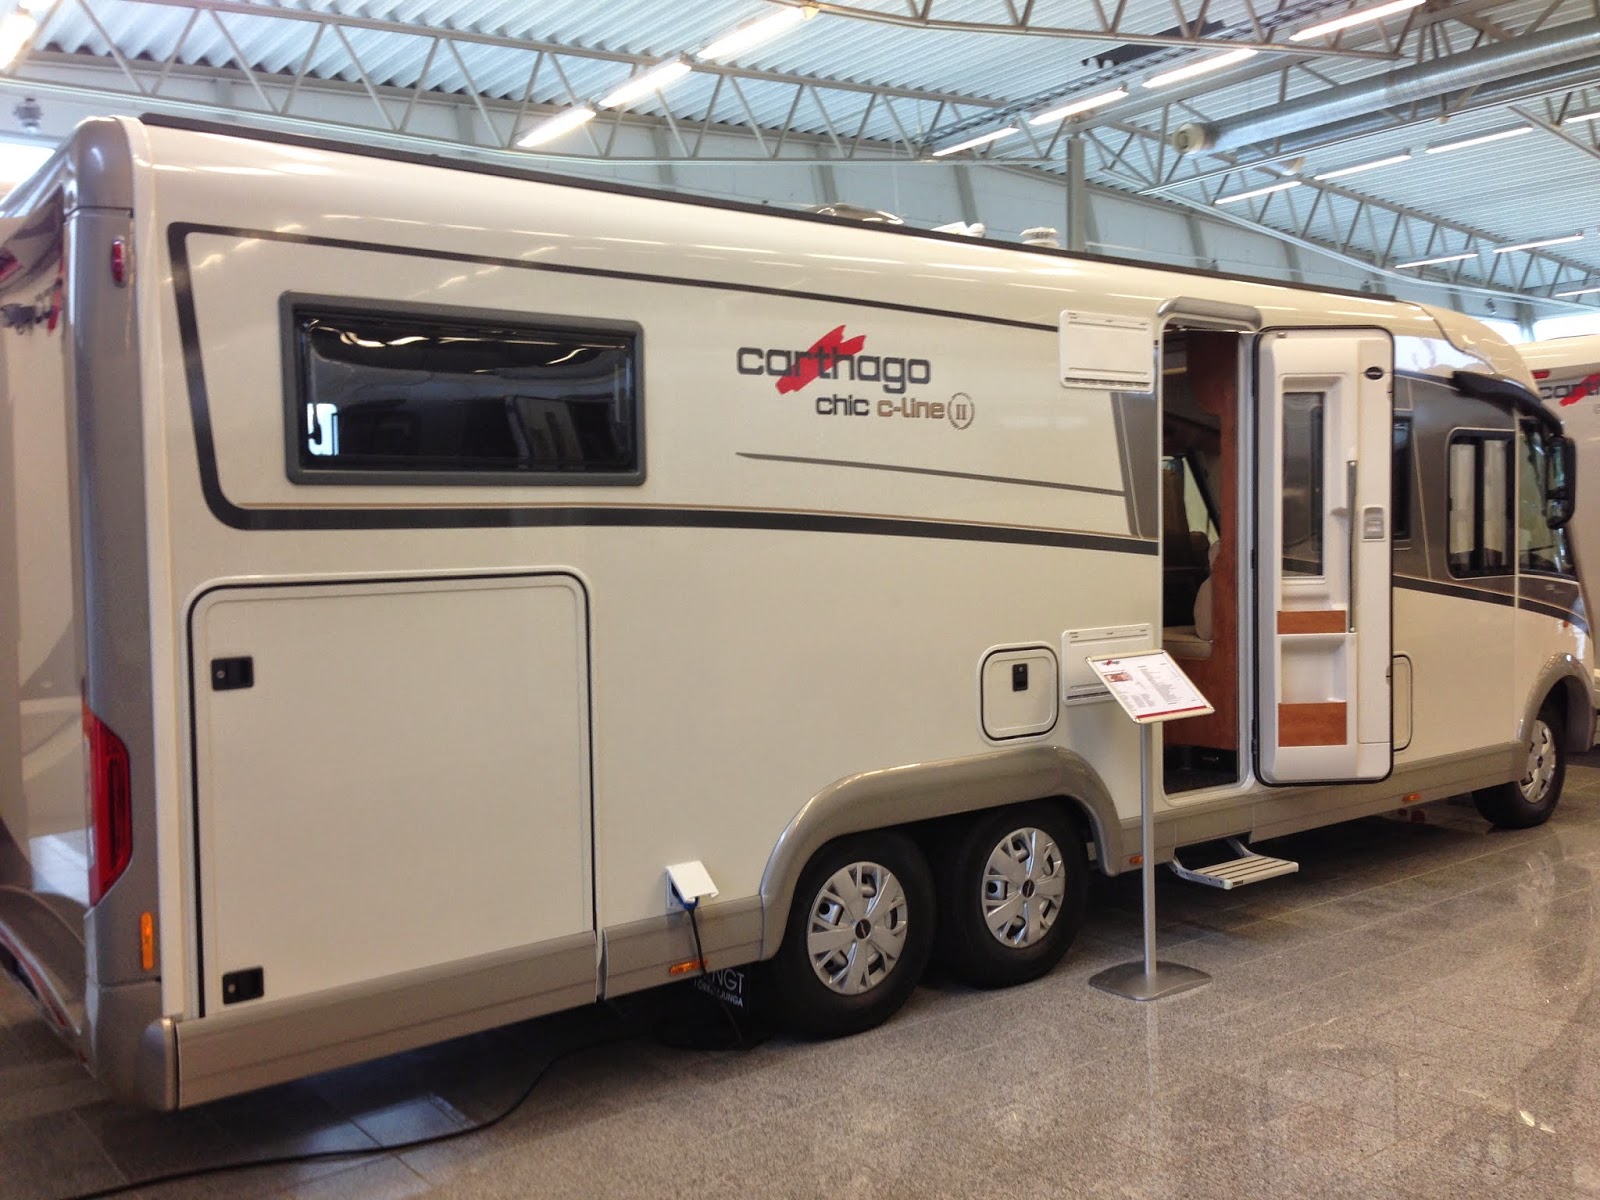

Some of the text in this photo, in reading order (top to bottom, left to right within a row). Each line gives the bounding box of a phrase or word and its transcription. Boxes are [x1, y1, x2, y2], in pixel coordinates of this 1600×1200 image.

[737, 346, 931, 394] carthago
[816, 394, 870, 416] chic
[877, 397, 946, 419] c-line
[711, 969, 745, 994] NGT
